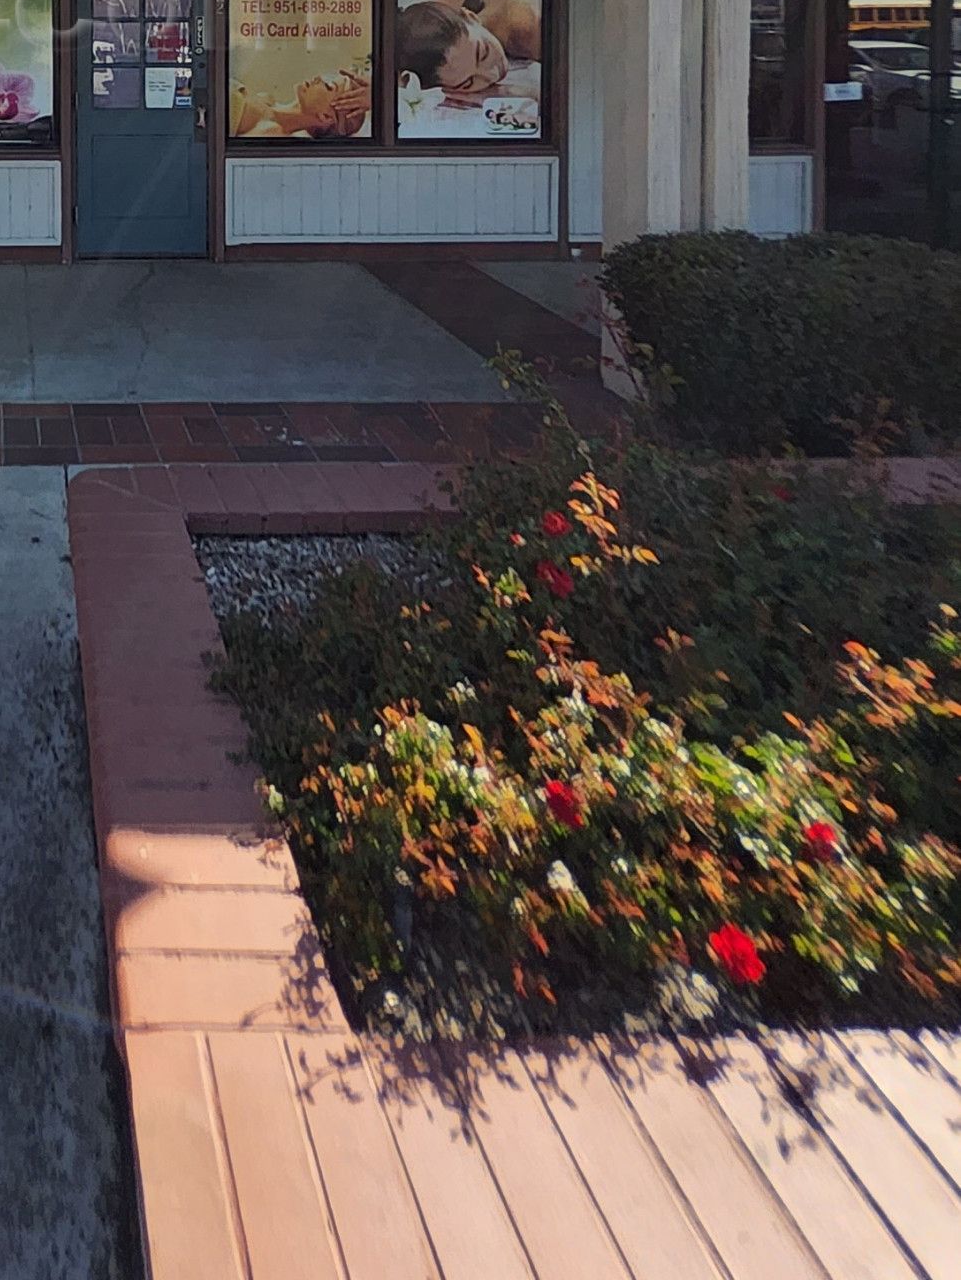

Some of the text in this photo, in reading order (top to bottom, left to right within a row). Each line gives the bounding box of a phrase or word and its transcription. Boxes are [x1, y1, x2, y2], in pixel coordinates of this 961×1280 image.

[241, 0, 363, 14] TEL: 951-689-2889
[240, 22, 363, 37] Gift Card Available
